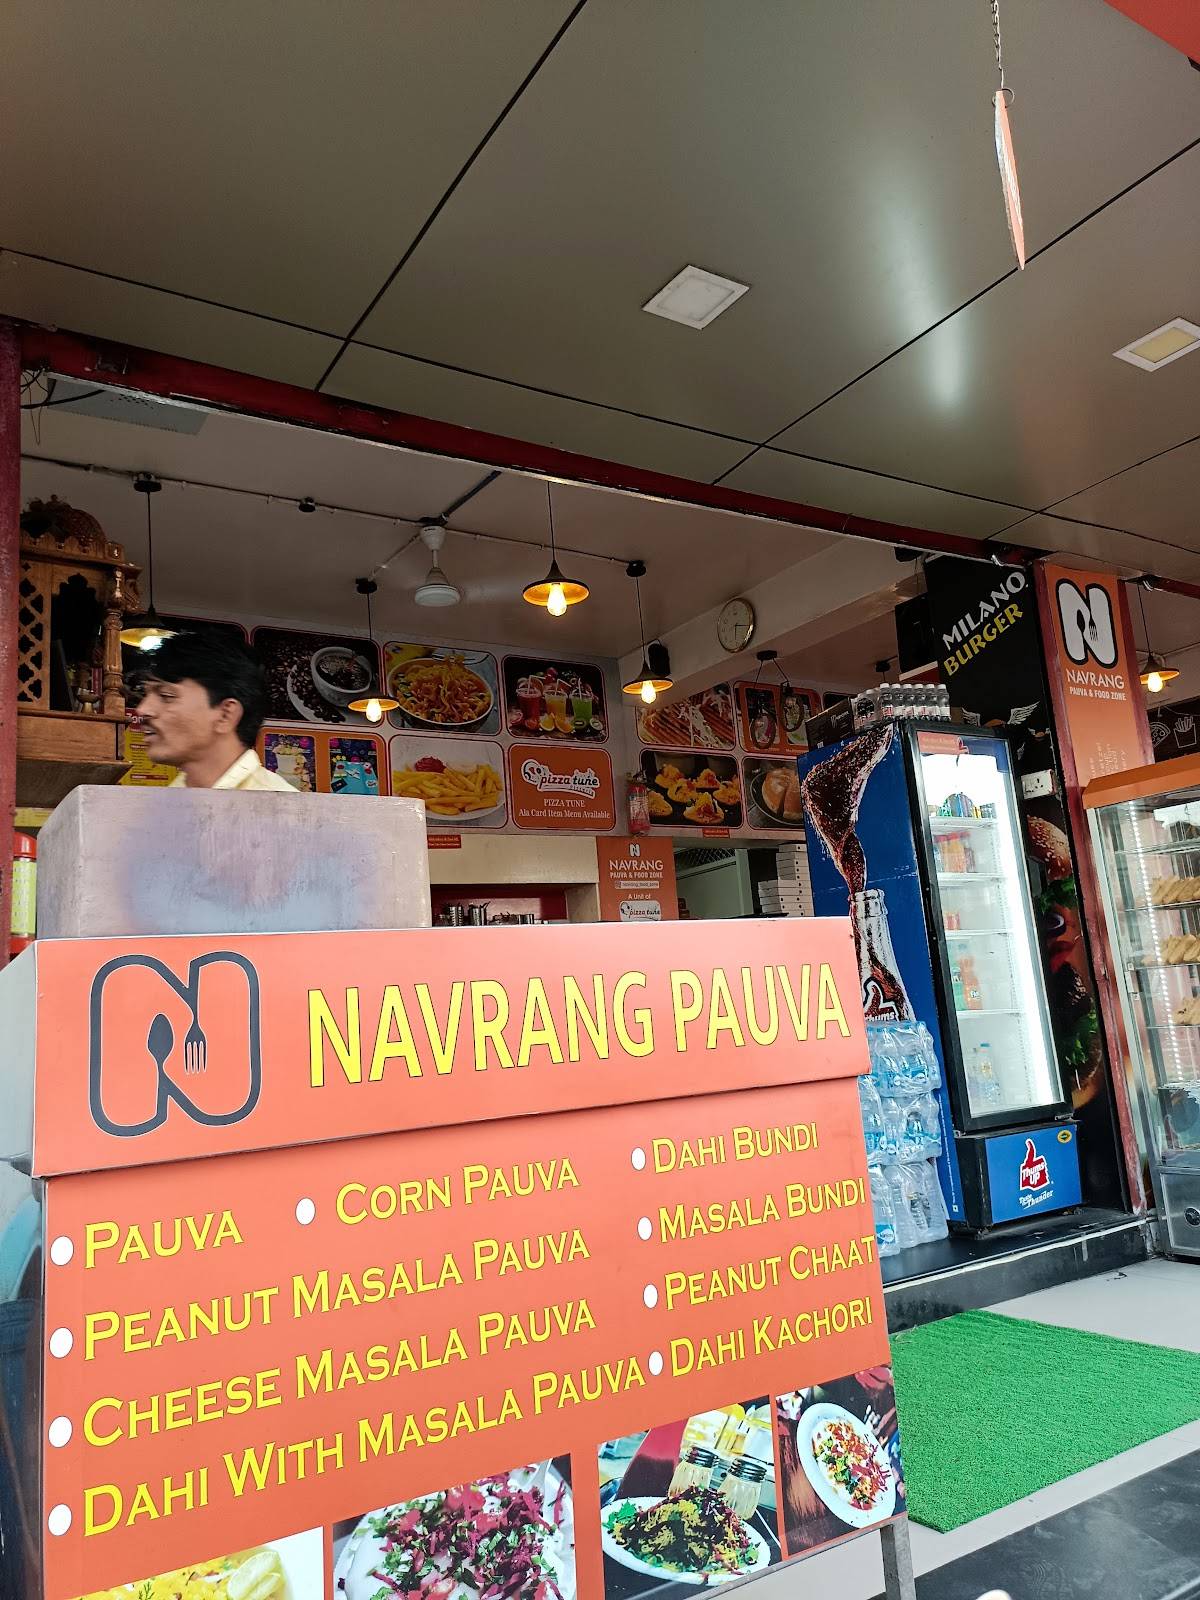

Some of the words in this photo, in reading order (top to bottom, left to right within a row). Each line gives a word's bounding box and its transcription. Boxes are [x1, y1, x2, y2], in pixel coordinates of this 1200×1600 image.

[942, 571, 1026, 651] MILANO
[943, 603, 1023, 676] BURGER
[1066, 668, 1125, 689] NAVRANG
[1069, 686, 1088, 697] PAUVA
[1094, 691, 1110, 699] FOOD
[1111, 692, 1127, 701] ZONE
[531, 809, 548, 817] Card
[564, 811, 582, 819] Menu
[582, 811, 611, 819] Available
[539, 774, 571, 789] pizza
[573, 776, 599, 786] tune
[544, 799, 565, 807] PIZZA
[567, 800, 586, 808] TUNE
[609, 860, 664, 871] NAVRANG
[307, 971, 656, 1088] NAVRANG
[669, 963, 851, 1053] PAUVA
[652, 1135, 726, 1174] DAHI
[733, 1122, 819, 1161] BUNDI
[1022, 1162, 1046, 1180] Thums
[336, 1175, 452, 1226] CORN
[462, 1158, 580, 1205] PAUVA
[658, 1194, 780, 1243] MASALA
[786, 1178, 866, 1218] BUNDI
[84, 1210, 244, 1269] PAUVA
[84, 1286, 279, 1361] PEANUT
[292, 1253, 463, 1319] MASALA
[473, 1229, 591, 1281] PAUVA
[664, 1256, 782, 1310] PEANUT
[789, 1235, 875, 1281] CHAAT
[670, 1329, 745, 1377] DAHI
[752, 1296, 873, 1355] KACHORI
[83, 1367, 282, 1447] CHEESE
[295, 1328, 469, 1400] MASALA
[478, 1299, 596, 1356] PAUVA
[83, 1467, 209, 1537] DAHI
[223, 1432, 344, 1497] WITH
[358, 1389, 523, 1463] MASALA
[532, 1356, 646, 1415] PAUVA
